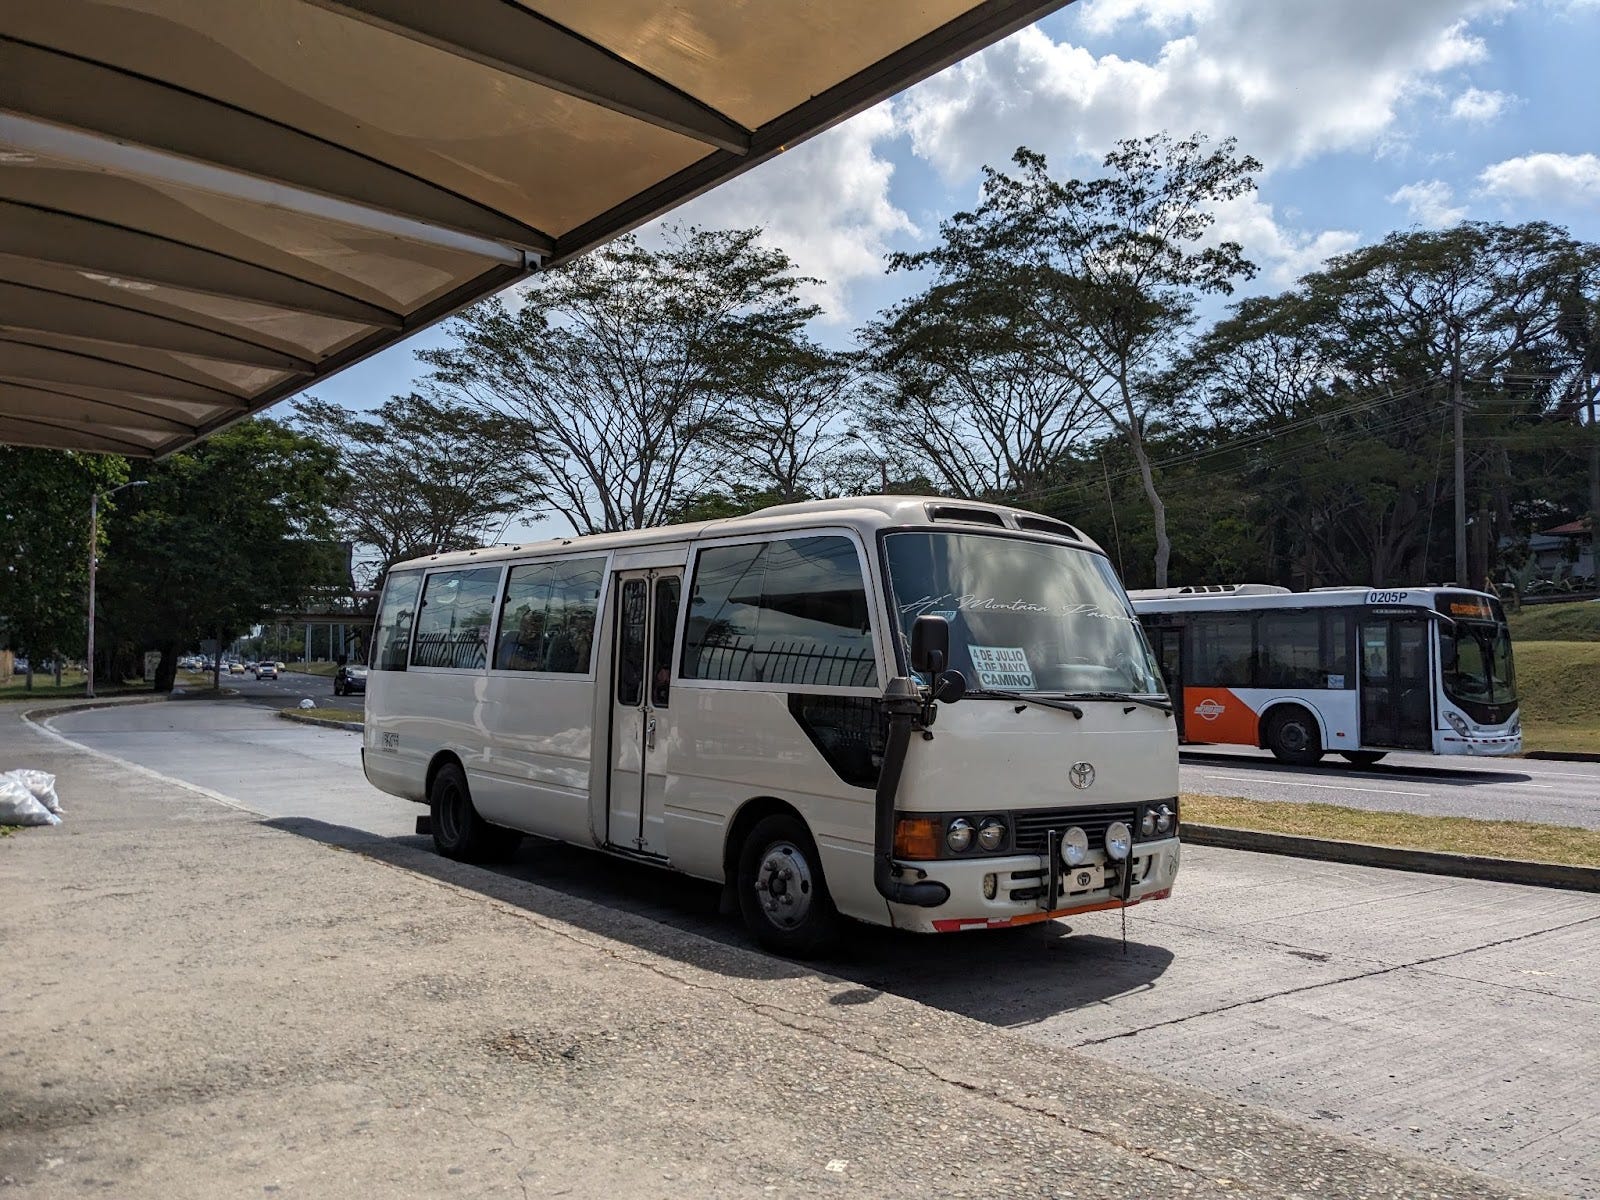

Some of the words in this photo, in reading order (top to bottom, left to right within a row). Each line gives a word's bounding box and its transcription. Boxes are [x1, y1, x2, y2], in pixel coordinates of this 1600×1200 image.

[1370, 591, 1408, 603] 0205P
[972, 649, 979, 660] 4
[979, 649, 994, 661] DE
[995, 650, 1023, 662] JULIO
[984, 662, 997, 672] DE
[999, 663, 1027, 672] MAYO
[981, 673, 1031, 687] CAMINO
